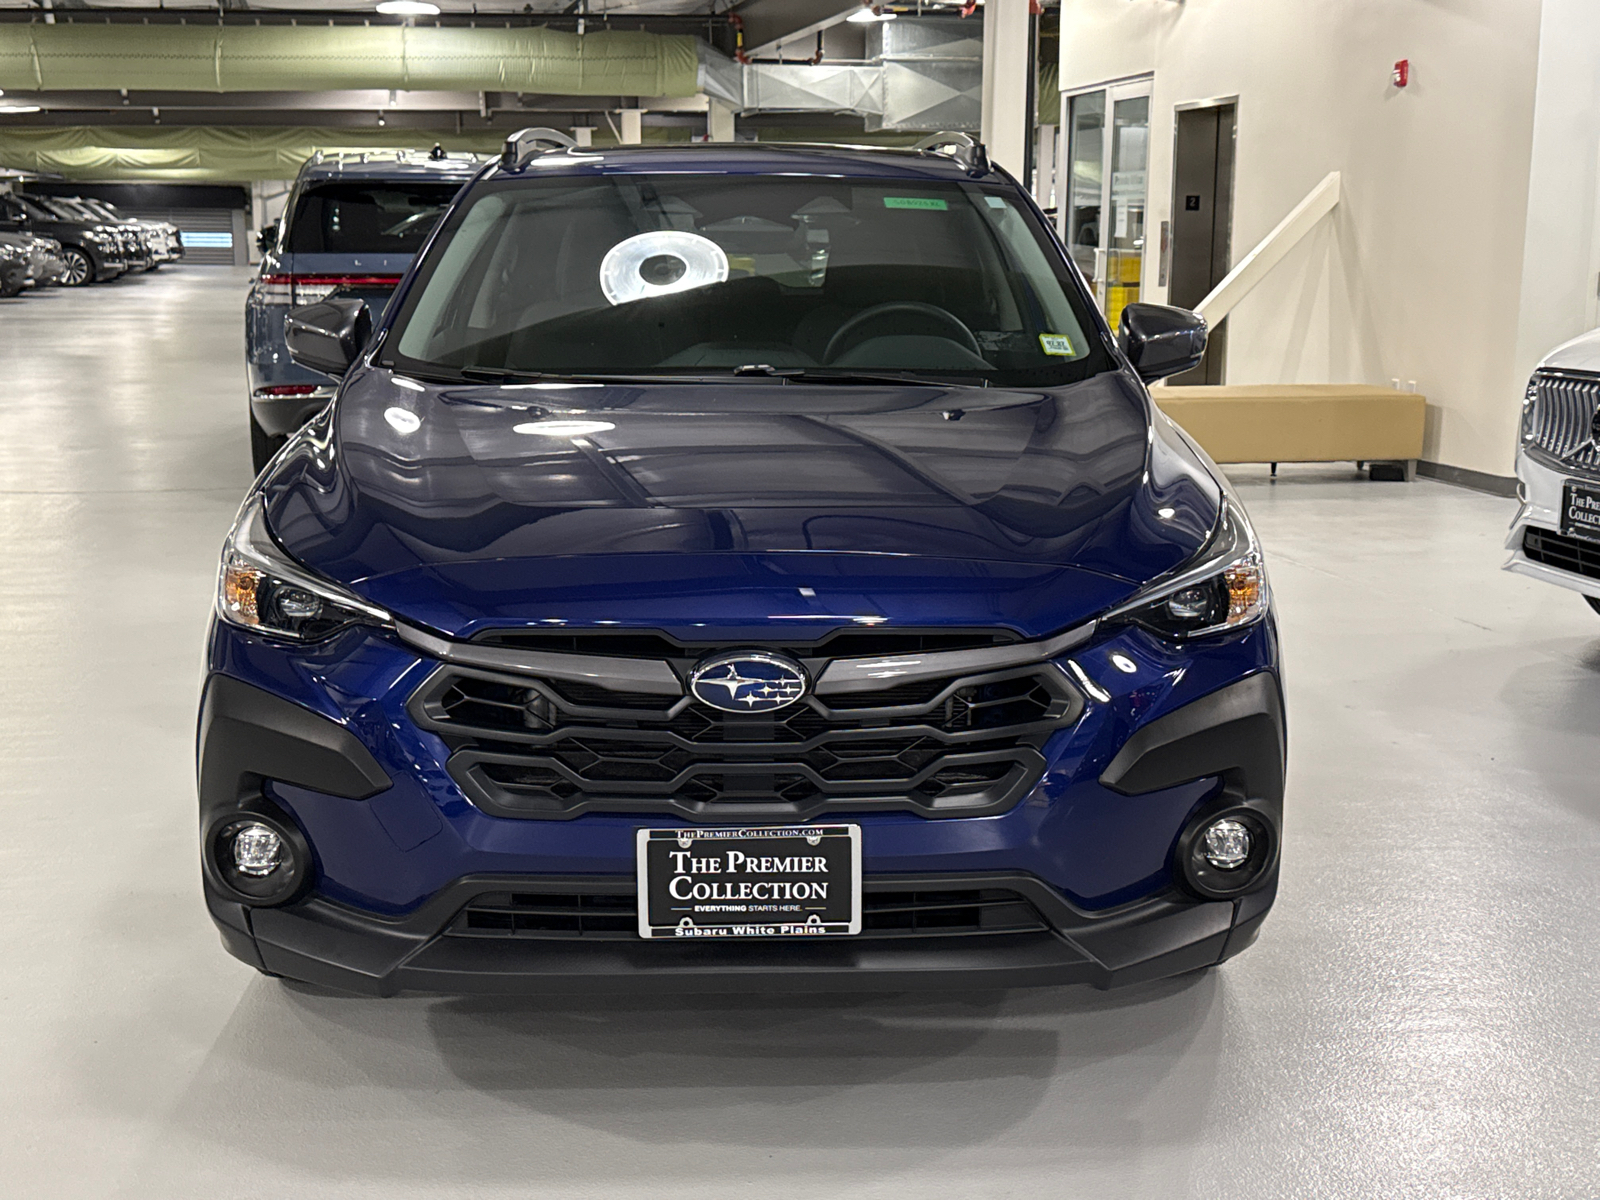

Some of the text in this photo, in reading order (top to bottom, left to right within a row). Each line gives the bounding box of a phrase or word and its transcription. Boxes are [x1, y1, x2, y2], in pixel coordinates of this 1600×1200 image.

[1570, 493, 1585, 507] THE
[669, 851, 829, 874] THE PREMIER
[669, 876, 829, 900] COLLECTION
[675, 925, 826, 937] Subaru White Plains
